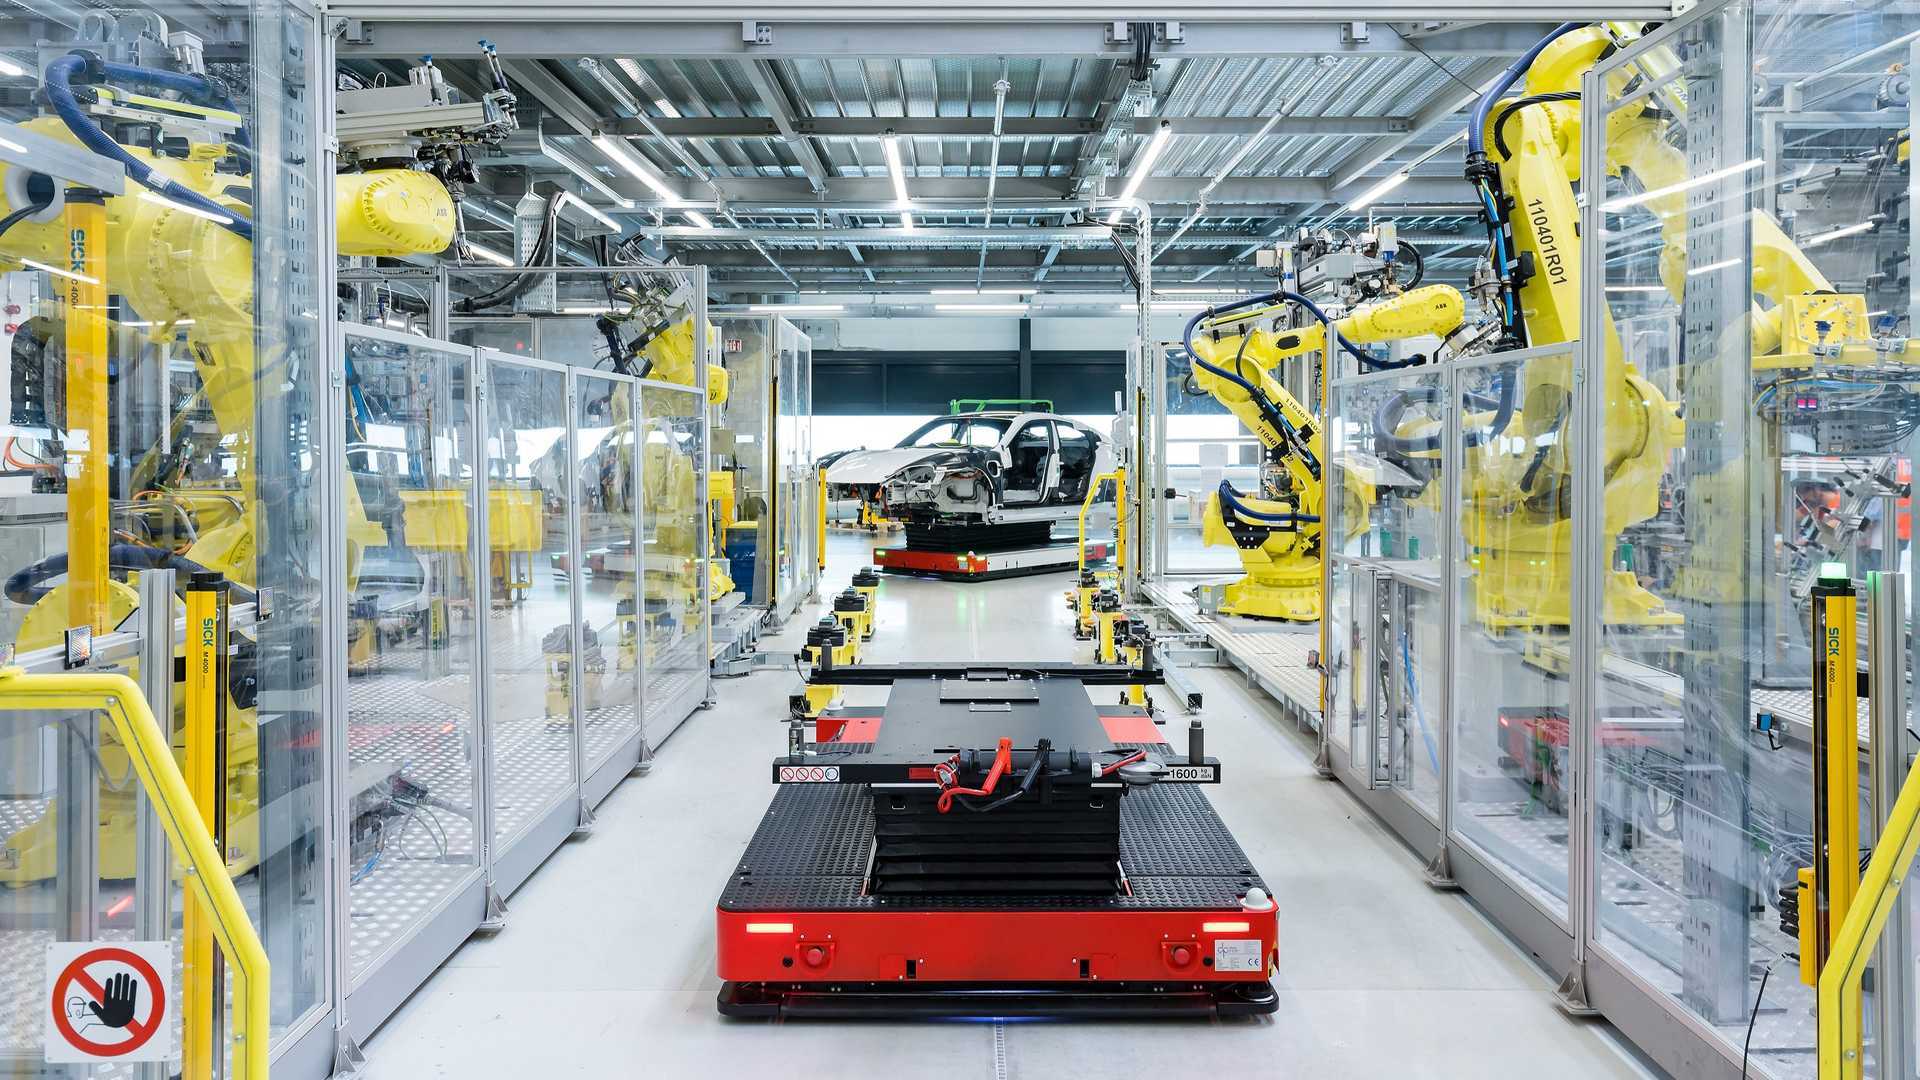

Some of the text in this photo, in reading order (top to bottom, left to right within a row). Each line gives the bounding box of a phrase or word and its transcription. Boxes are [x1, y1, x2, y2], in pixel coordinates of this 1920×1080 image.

[70, 229, 85, 273] SICK
[1528, 198, 1568, 285] 110401R01
[203, 617, 214, 647] SICK
[1828, 627, 1840, 656] SICK
[1170, 768, 1198, 779] 1600
